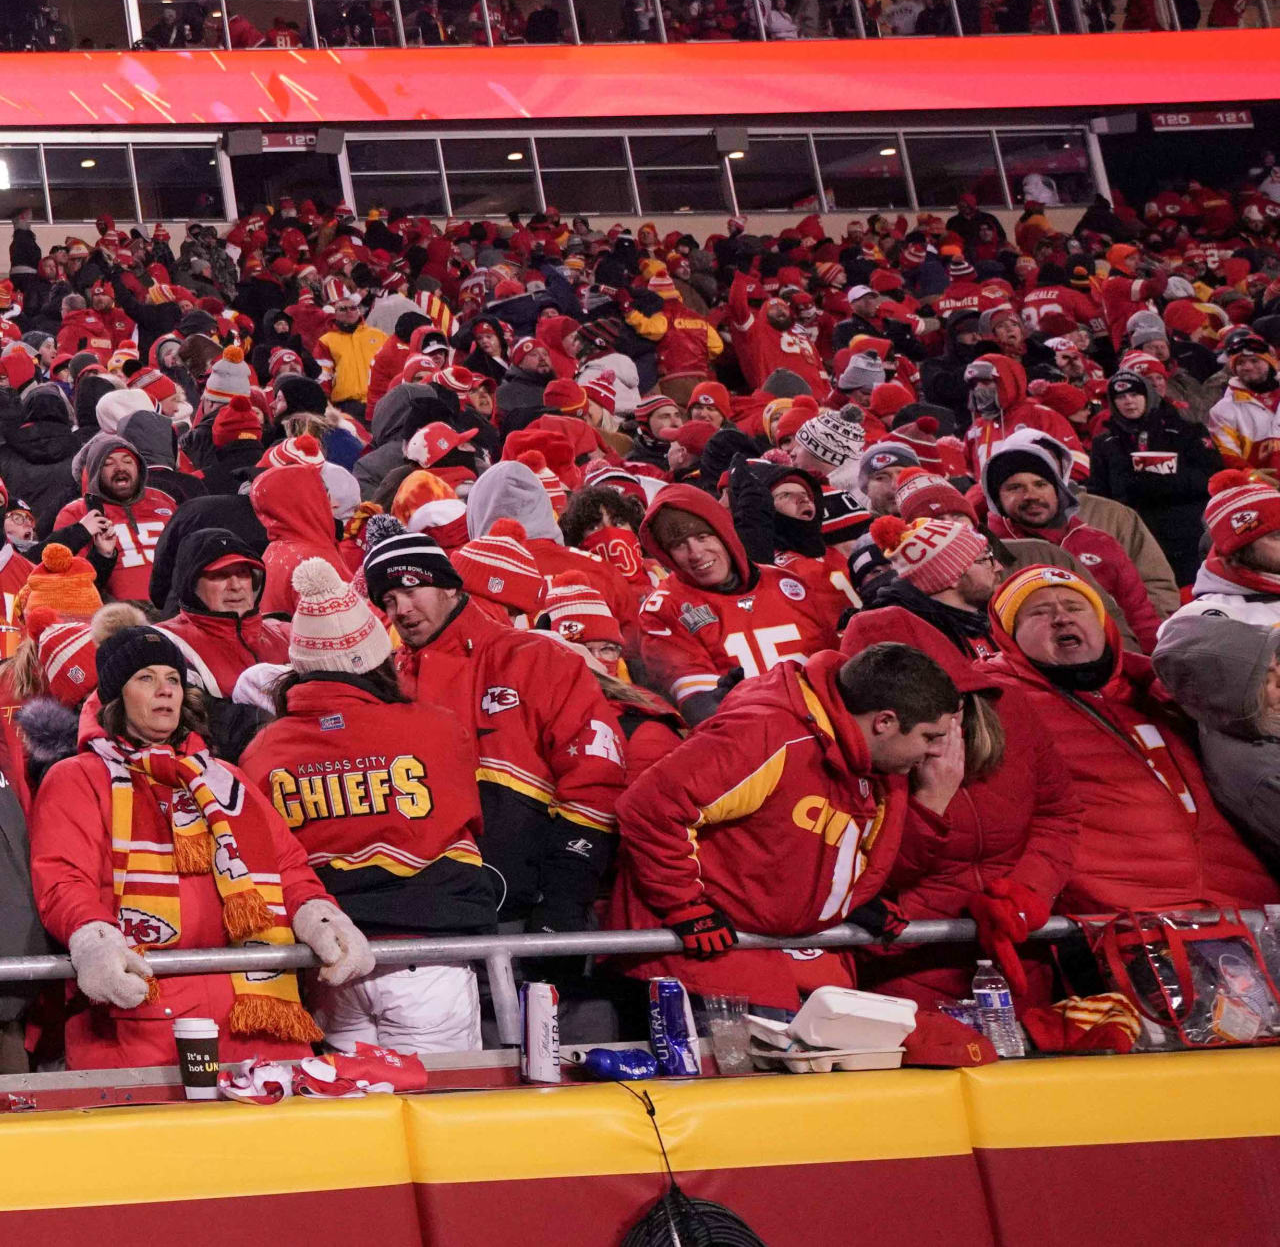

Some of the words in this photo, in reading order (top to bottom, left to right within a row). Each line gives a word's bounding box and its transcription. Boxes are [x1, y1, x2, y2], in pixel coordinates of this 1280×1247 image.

[1156, 115, 1189, 124] 120
[1216, 113, 1247, 123] 121
[799, 430, 849, 466] ORTH
[114, 521, 166, 568] 15
[387, 566, 406, 574] SUPER
[407, 566, 423, 576] BOWL
[723, 623, 810, 679] 15
[298, 760, 352, 774] KANSAS
[355, 755, 388, 769] CITY
[269, 755, 434, 830] CHIEFS
[552, 1013, 560, 1066] ULTRA
[650, 1006, 669, 1059] ULTRA
[187, 1052, 202, 1061] It's
[188, 1064, 204, 1072] hot
